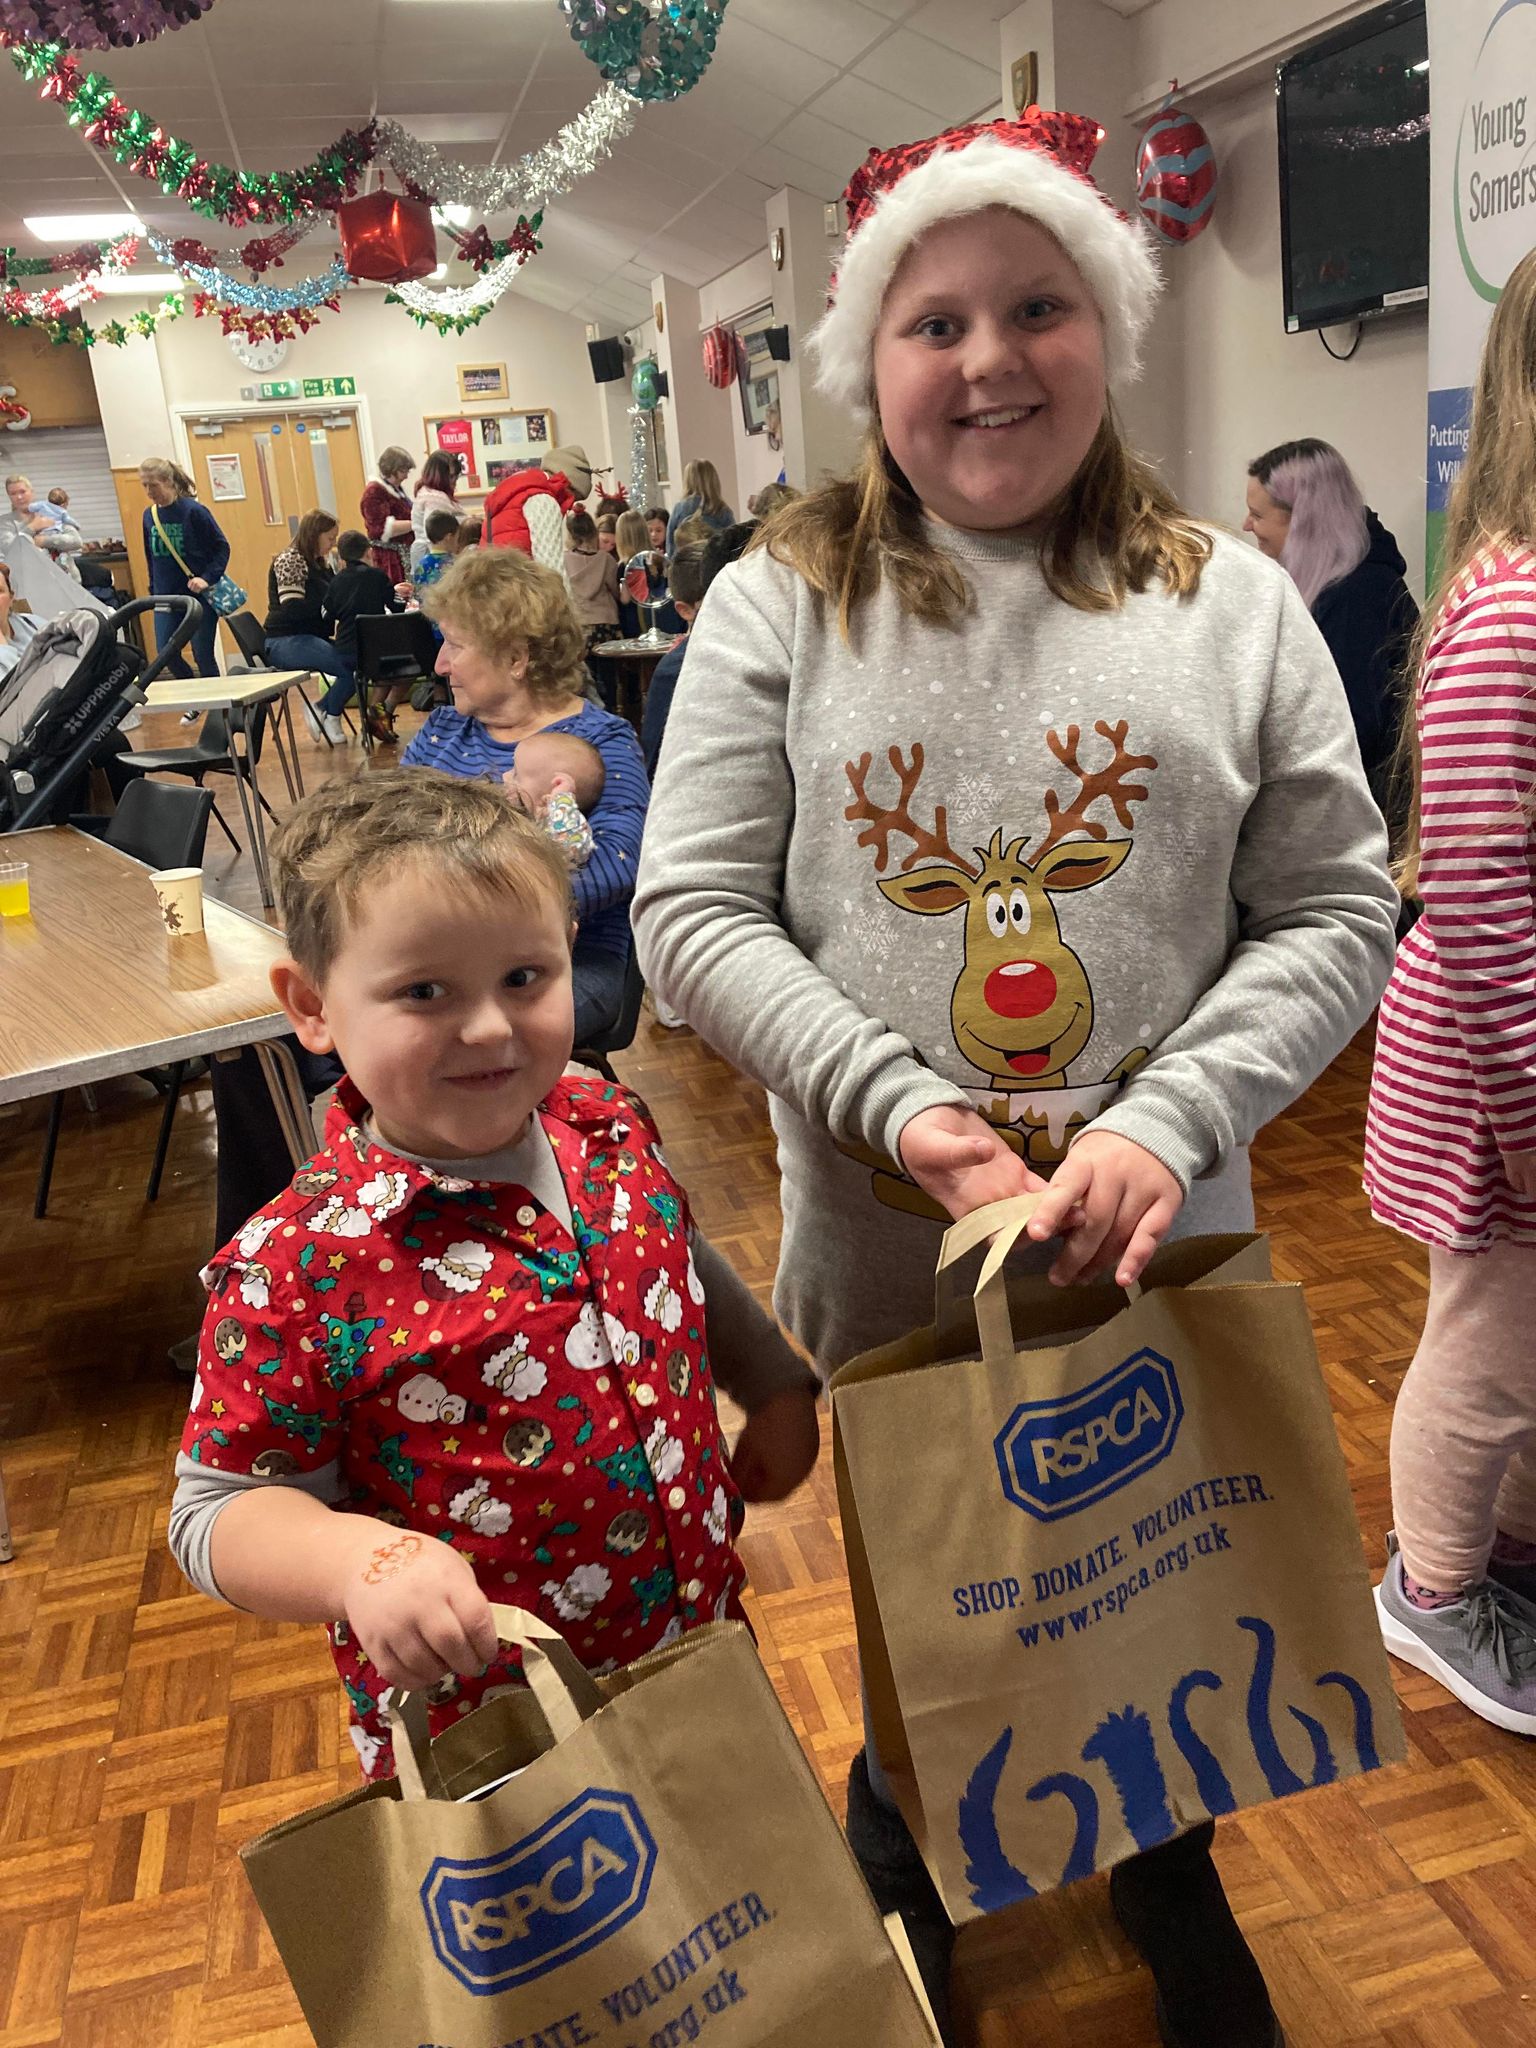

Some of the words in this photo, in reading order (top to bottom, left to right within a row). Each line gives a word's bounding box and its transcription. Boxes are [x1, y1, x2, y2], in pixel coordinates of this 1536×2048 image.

[1472, 97, 1527, 154] Young
[1470, 164, 1536, 222] Somers
[304, 380, 319, 388] Fire
[305, 389, 320, 397] exit
[442, 432, 469, 444] TAYLOR
[453, 452, 470, 475] 3
[1430, 424, 1470, 453] Putting
[93, 714, 121, 742] VISTA
[1031, 1385, 1161, 1485] RSPCA
[952, 1576, 1025, 1617] SHOP.
[1031, 1535, 1128, 1602] DONATE.
[1132, 1473, 1275, 1549] VOLUNTEER.
[1016, 1521, 1232, 1649] www.rspca.org.uk
[449, 1836, 628, 1952] RSPCA
[600, 1891, 778, 2026] VOLUNTEER.
